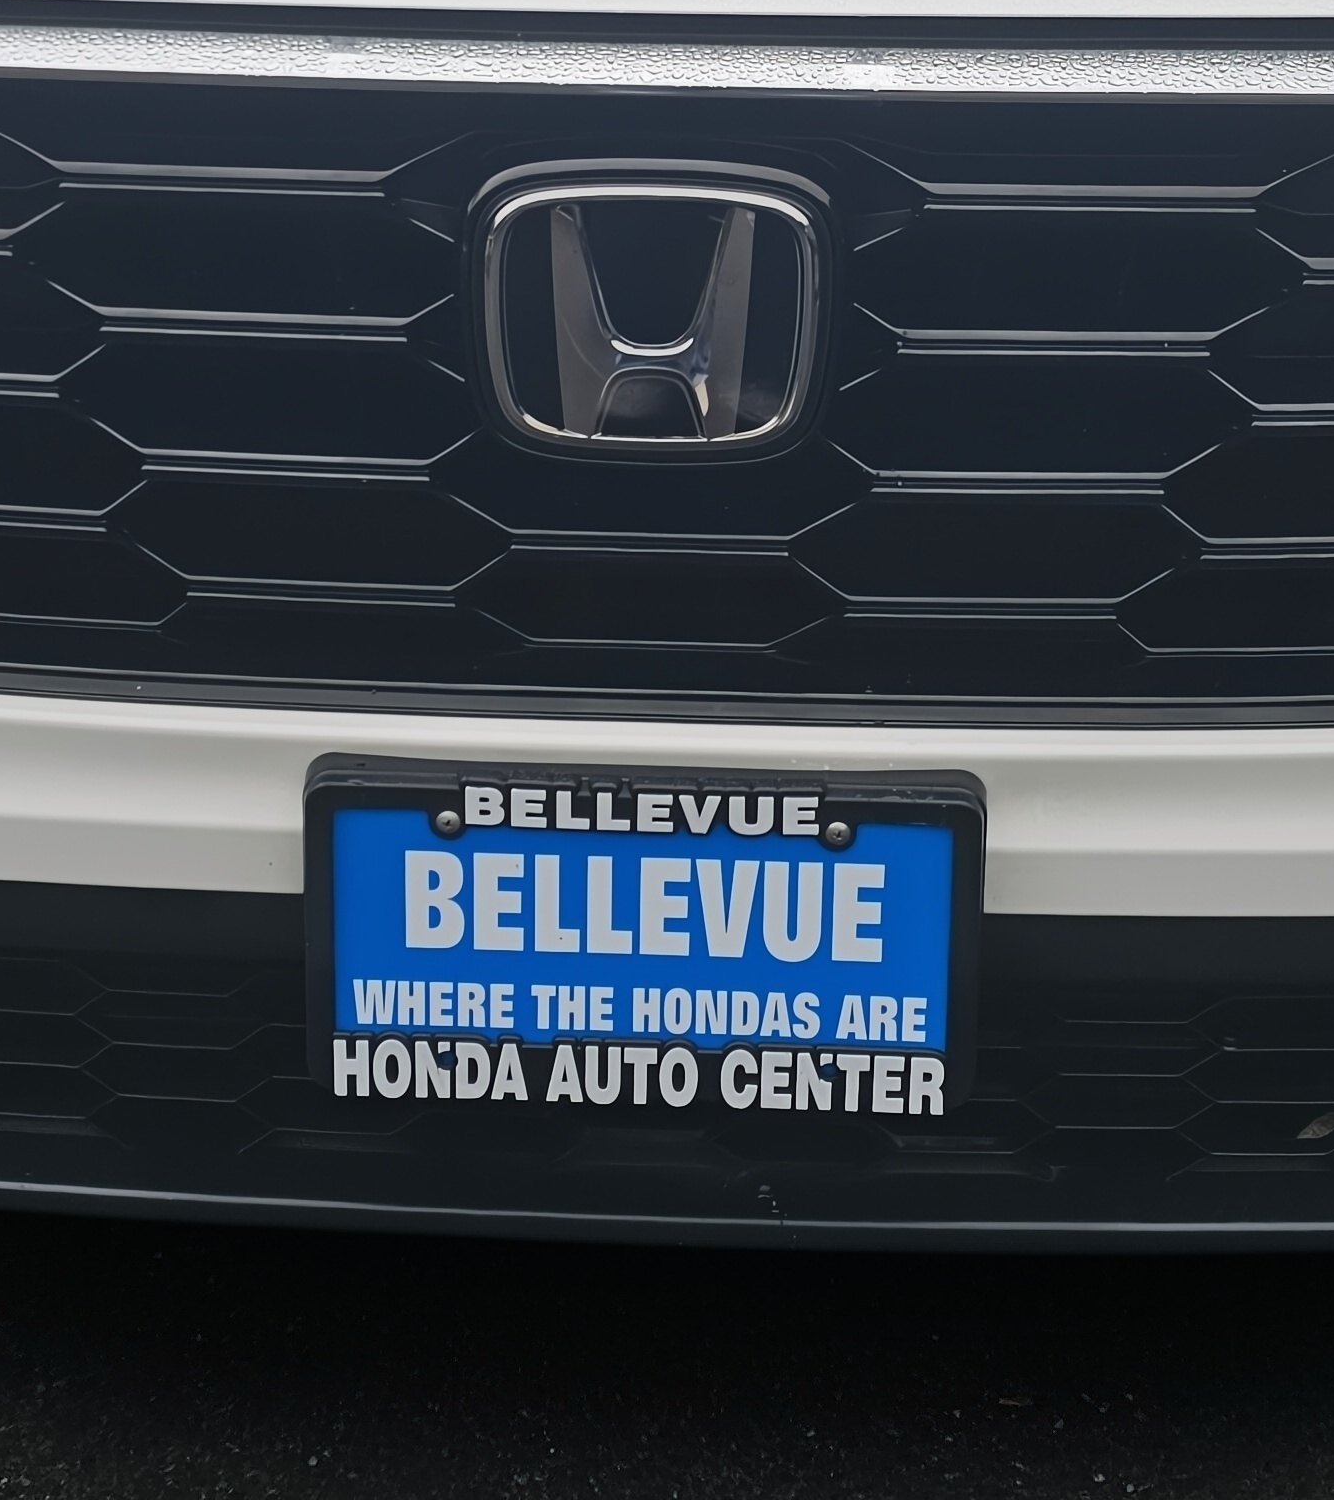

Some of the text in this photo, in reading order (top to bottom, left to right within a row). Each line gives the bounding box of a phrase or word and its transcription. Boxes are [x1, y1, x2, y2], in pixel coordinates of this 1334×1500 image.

[464, 785, 820, 836] BELLEVUE
[404, 850, 886, 963] BELLEVUE
[353, 979, 928, 1043] WHERE THE HONDAS ARE
[333, 1039, 945, 1116] HONDA AUTO CENTER
